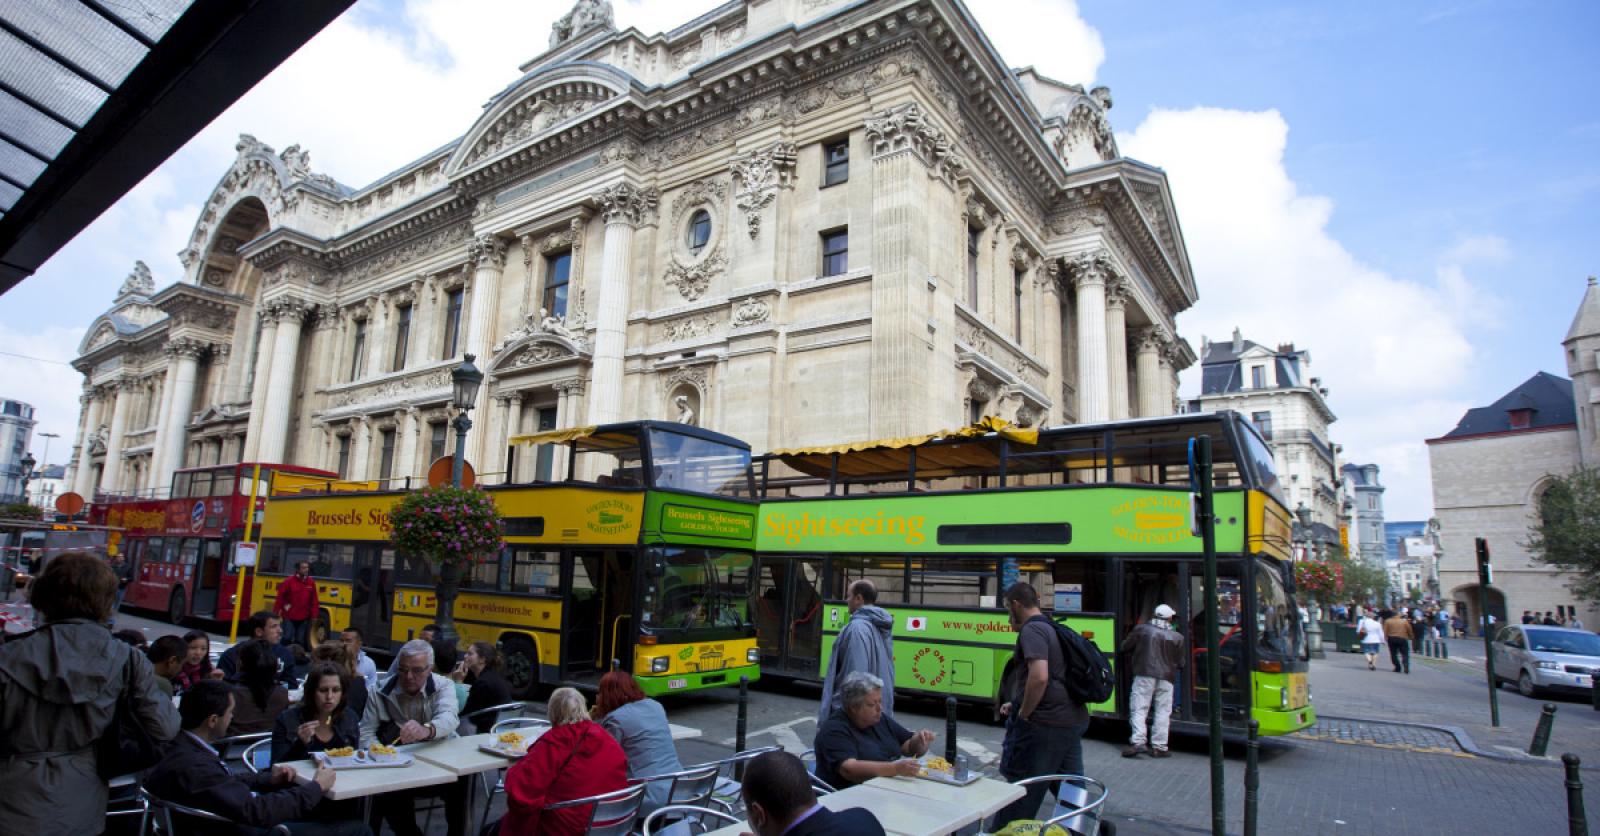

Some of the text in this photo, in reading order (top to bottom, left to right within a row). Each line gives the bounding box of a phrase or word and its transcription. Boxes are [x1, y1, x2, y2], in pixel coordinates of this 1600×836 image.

[307, 509, 362, 526] Brussels
[668, 507, 750, 529] Brussels Sightseeing
[764, 511, 926, 546] Sightseeing
